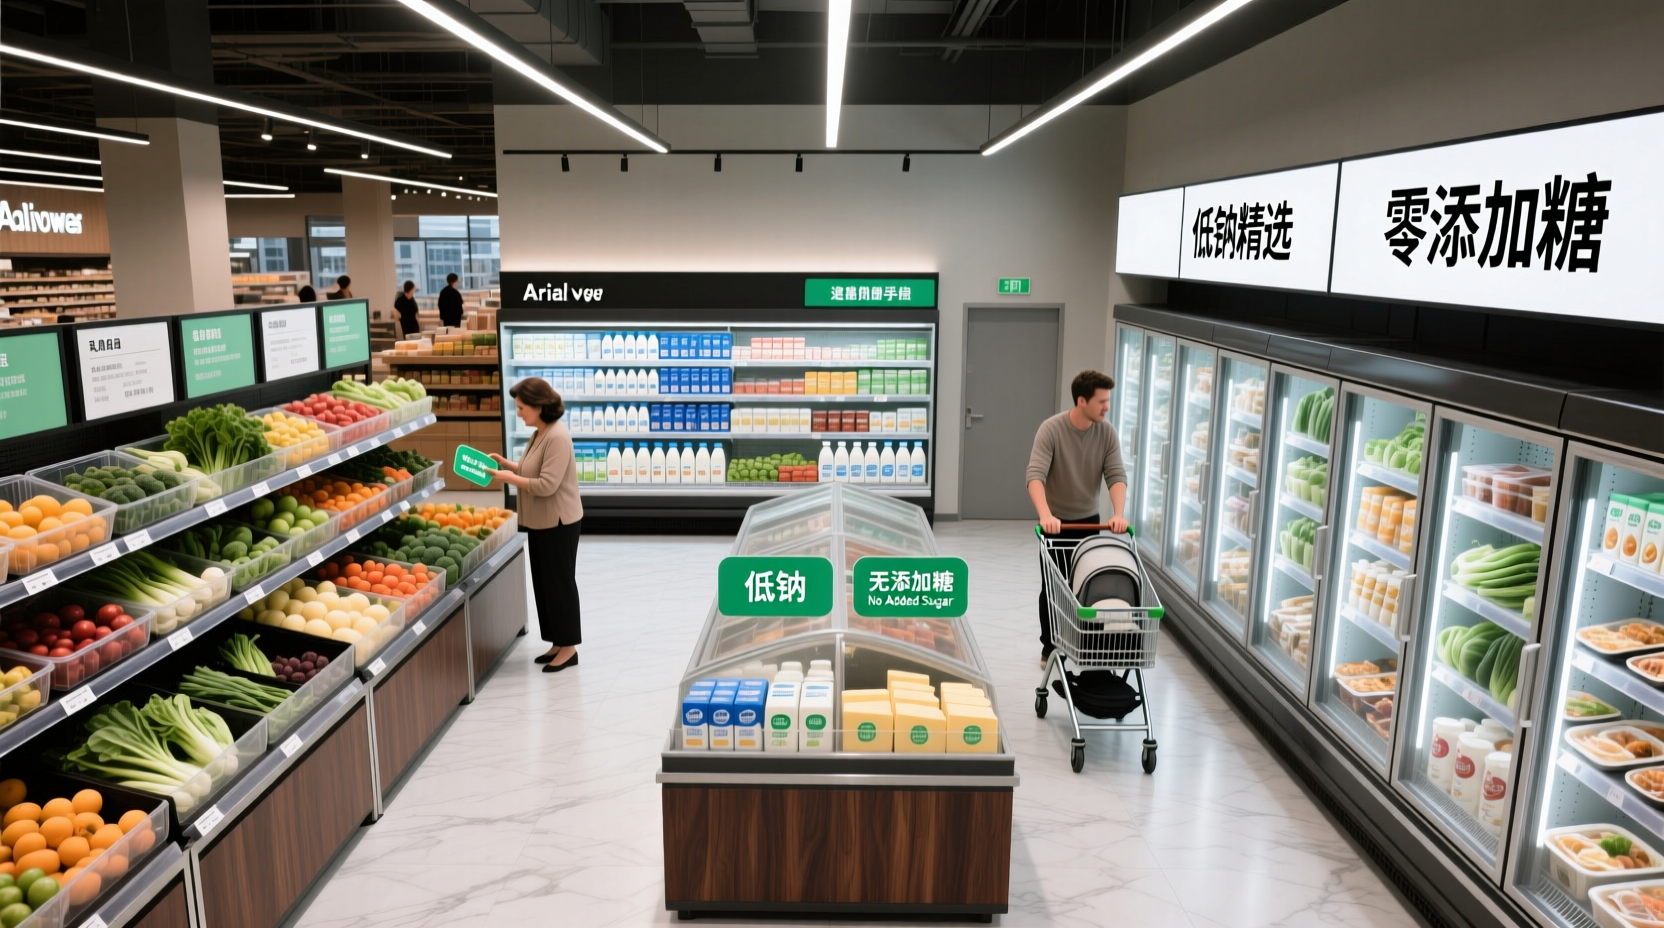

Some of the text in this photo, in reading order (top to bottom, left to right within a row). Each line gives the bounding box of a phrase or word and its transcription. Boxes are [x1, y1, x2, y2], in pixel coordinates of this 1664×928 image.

[1192, 199, 1294, 261] 低钠精选
[1384, 171, 1612, 273] 零添加糖
[522, 282, 568, 302] Arial
[744, 570, 806, 604] 低钠
[869, 570, 954, 592] 无添加糖
[868, 595, 882, 606] No
